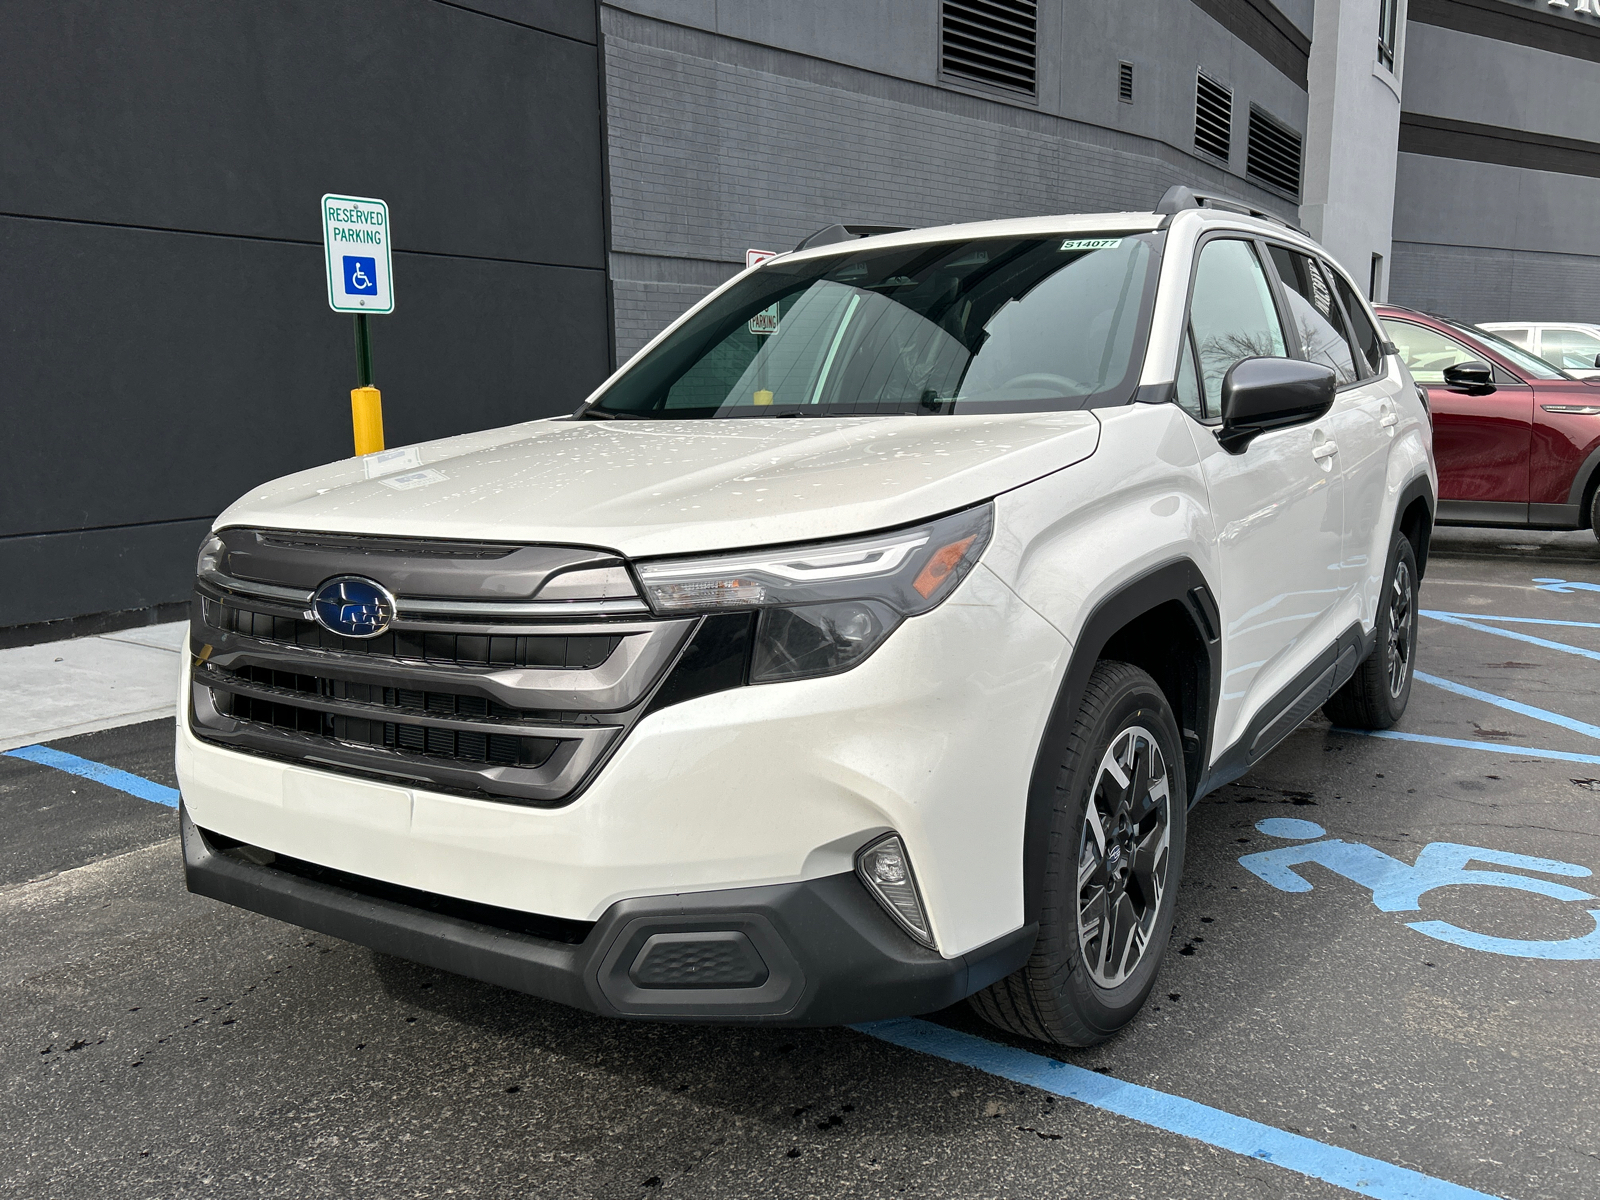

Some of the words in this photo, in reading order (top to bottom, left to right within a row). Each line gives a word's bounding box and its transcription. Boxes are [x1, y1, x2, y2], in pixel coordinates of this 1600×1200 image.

[329, 207, 383, 225] RESERVED
[333, 227, 381, 244] PARKING
[1064, 240, 1117, 248] S14077
